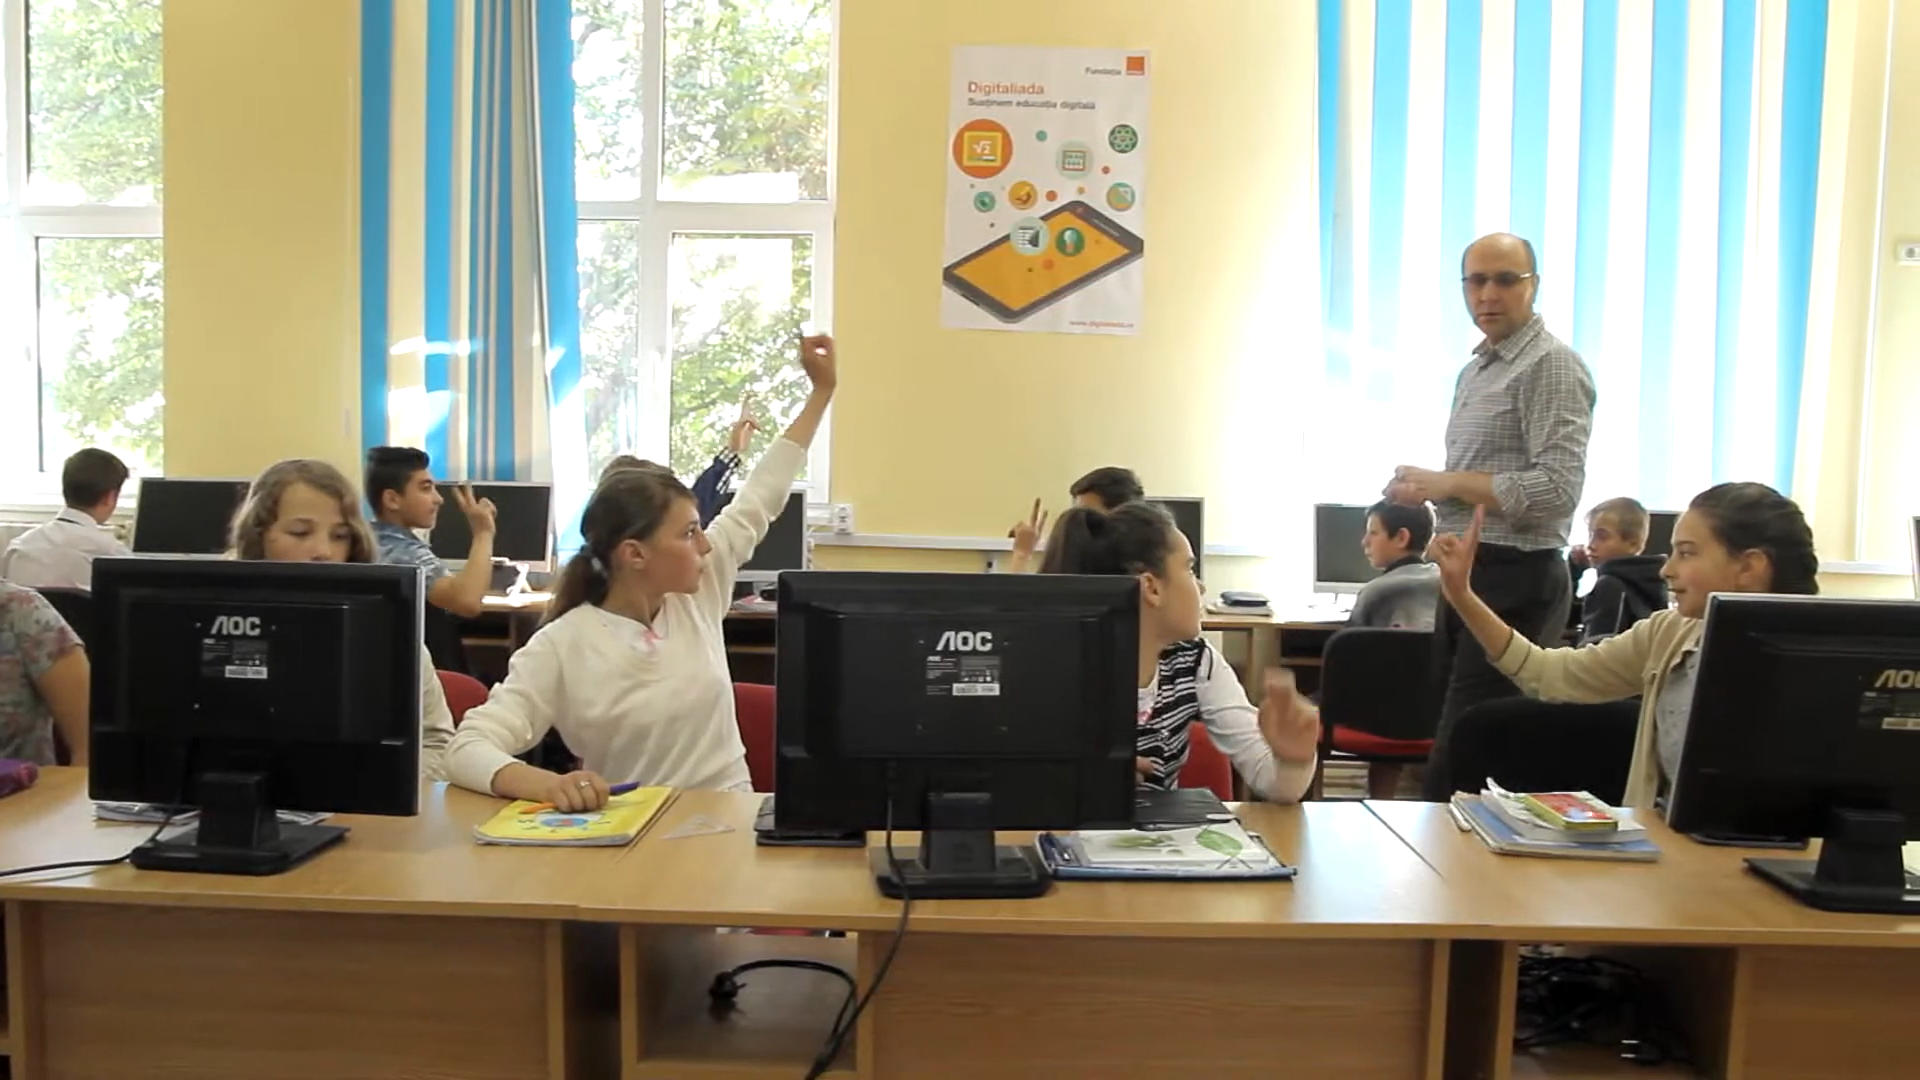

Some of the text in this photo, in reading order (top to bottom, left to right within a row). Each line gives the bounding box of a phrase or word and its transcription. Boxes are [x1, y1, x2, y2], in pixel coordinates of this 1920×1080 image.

[968, 81, 1045, 96] Digitaliada
[210, 615, 262, 636] AOC
[936, 630, 993, 652] AOC
[1874, 669, 1920, 688] AO
